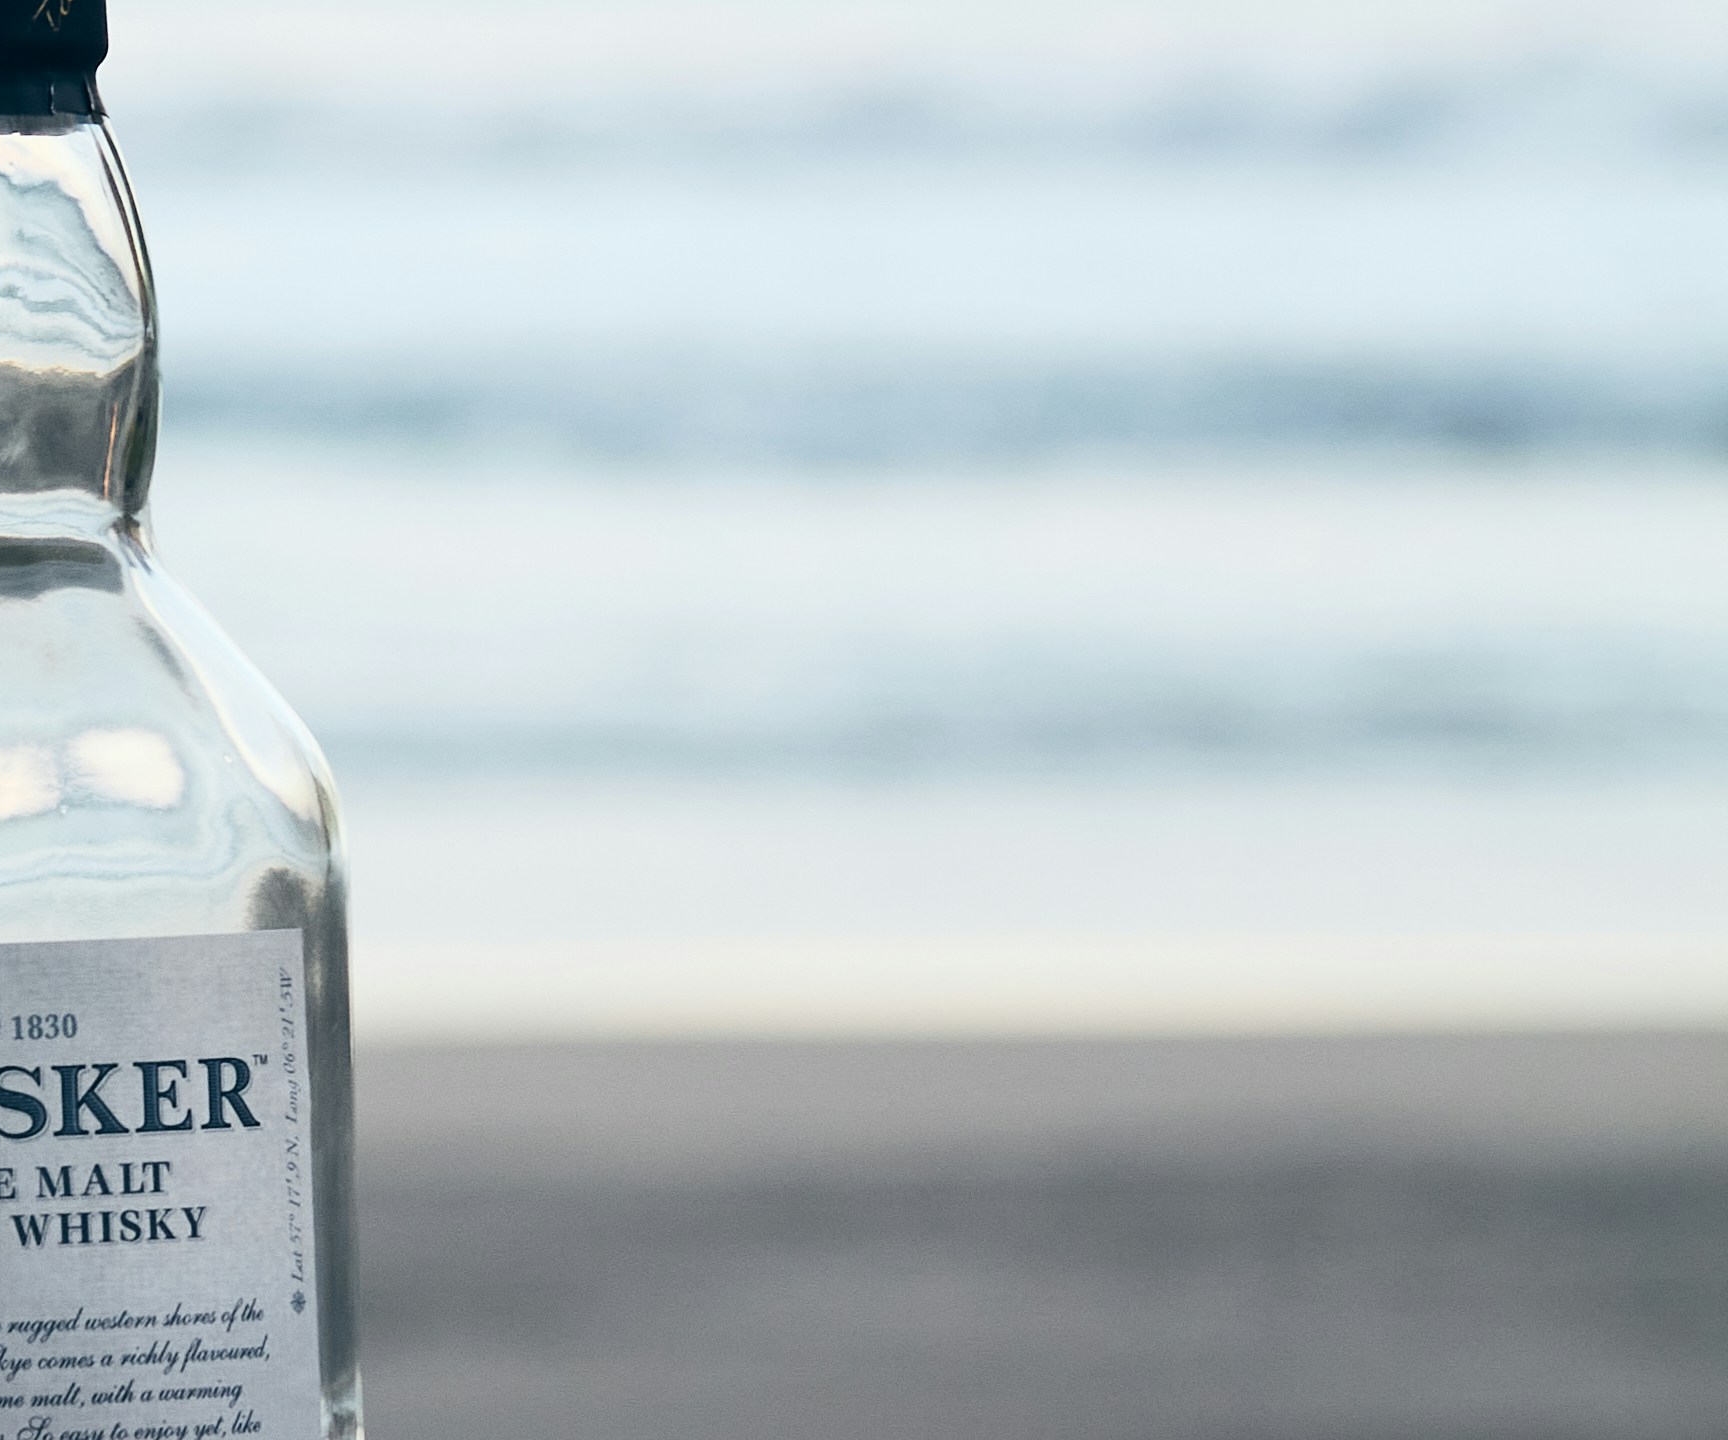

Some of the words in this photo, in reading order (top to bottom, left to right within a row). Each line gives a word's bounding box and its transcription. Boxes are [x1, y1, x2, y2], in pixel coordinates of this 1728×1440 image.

[10, 1012, 79, 1041] 1830
[282, 1079, 302, 1125] Long
[37, 1160, 173, 1200] MALT
[13, 1205, 208, 1249] WHISKY
[7, 1308, 83, 1345] rugged
[84, 1310, 158, 1331] western
[162, 1302, 217, 1327] shores
[220, 1297, 243, 1332] of
[241, 1298, 265, 1322] the
[38, 1353, 95, 1369] comes
[100, 1353, 114, 1367] a
[120, 1340, 180, 1375] richly
[179, 1334, 271, 1373] flavoured,
[30, 1381, 84, 1409] malt,
[91, 1380, 135, 1405] with
[140, 1388, 153, 1403] a
[158, 1379, 243, 1409] warming
[110, 1422, 129, 1440] to
[231, 1410, 261, 1435] like
